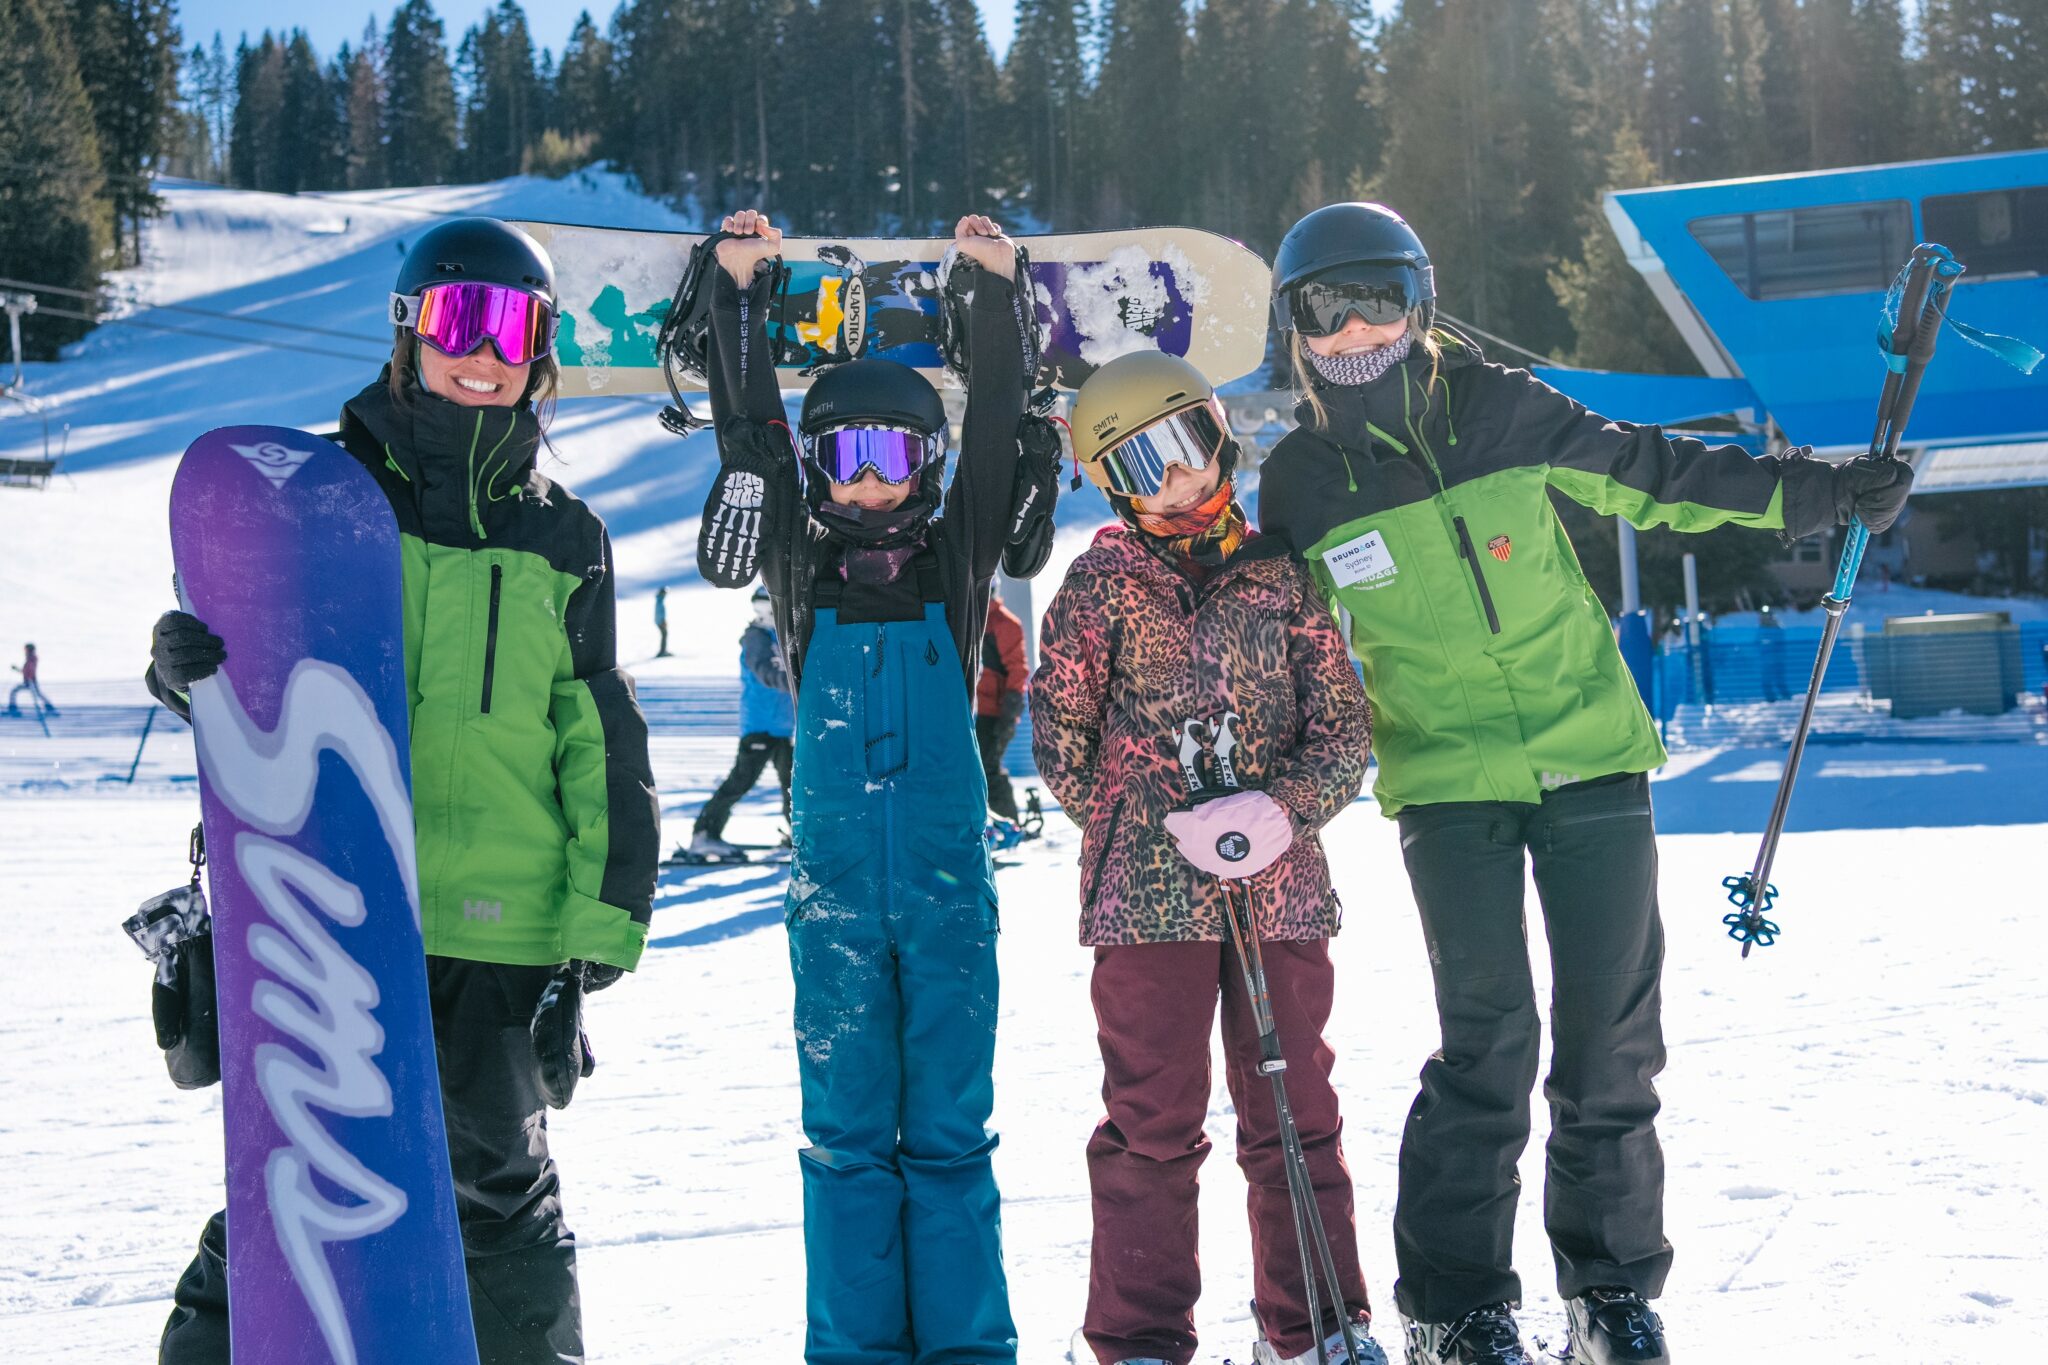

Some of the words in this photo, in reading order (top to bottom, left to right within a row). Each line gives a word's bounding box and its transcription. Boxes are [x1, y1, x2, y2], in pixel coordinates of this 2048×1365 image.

[848, 284, 861, 346] SLAPSTICK
[1126, 297, 1143, 329] GRAB
[809, 401, 834, 419] SMITH
[1092, 412, 1119, 435] SMITH
[721, 485, 763, 509] CRAB
[1332, 540, 1377, 563] BRUNDAGE
[1344, 554, 1373, 570] Sydney
[1185, 765, 1200, 790] LEK
[1220, 756, 1234, 786] LEKI
[463, 899, 502, 923] HH
